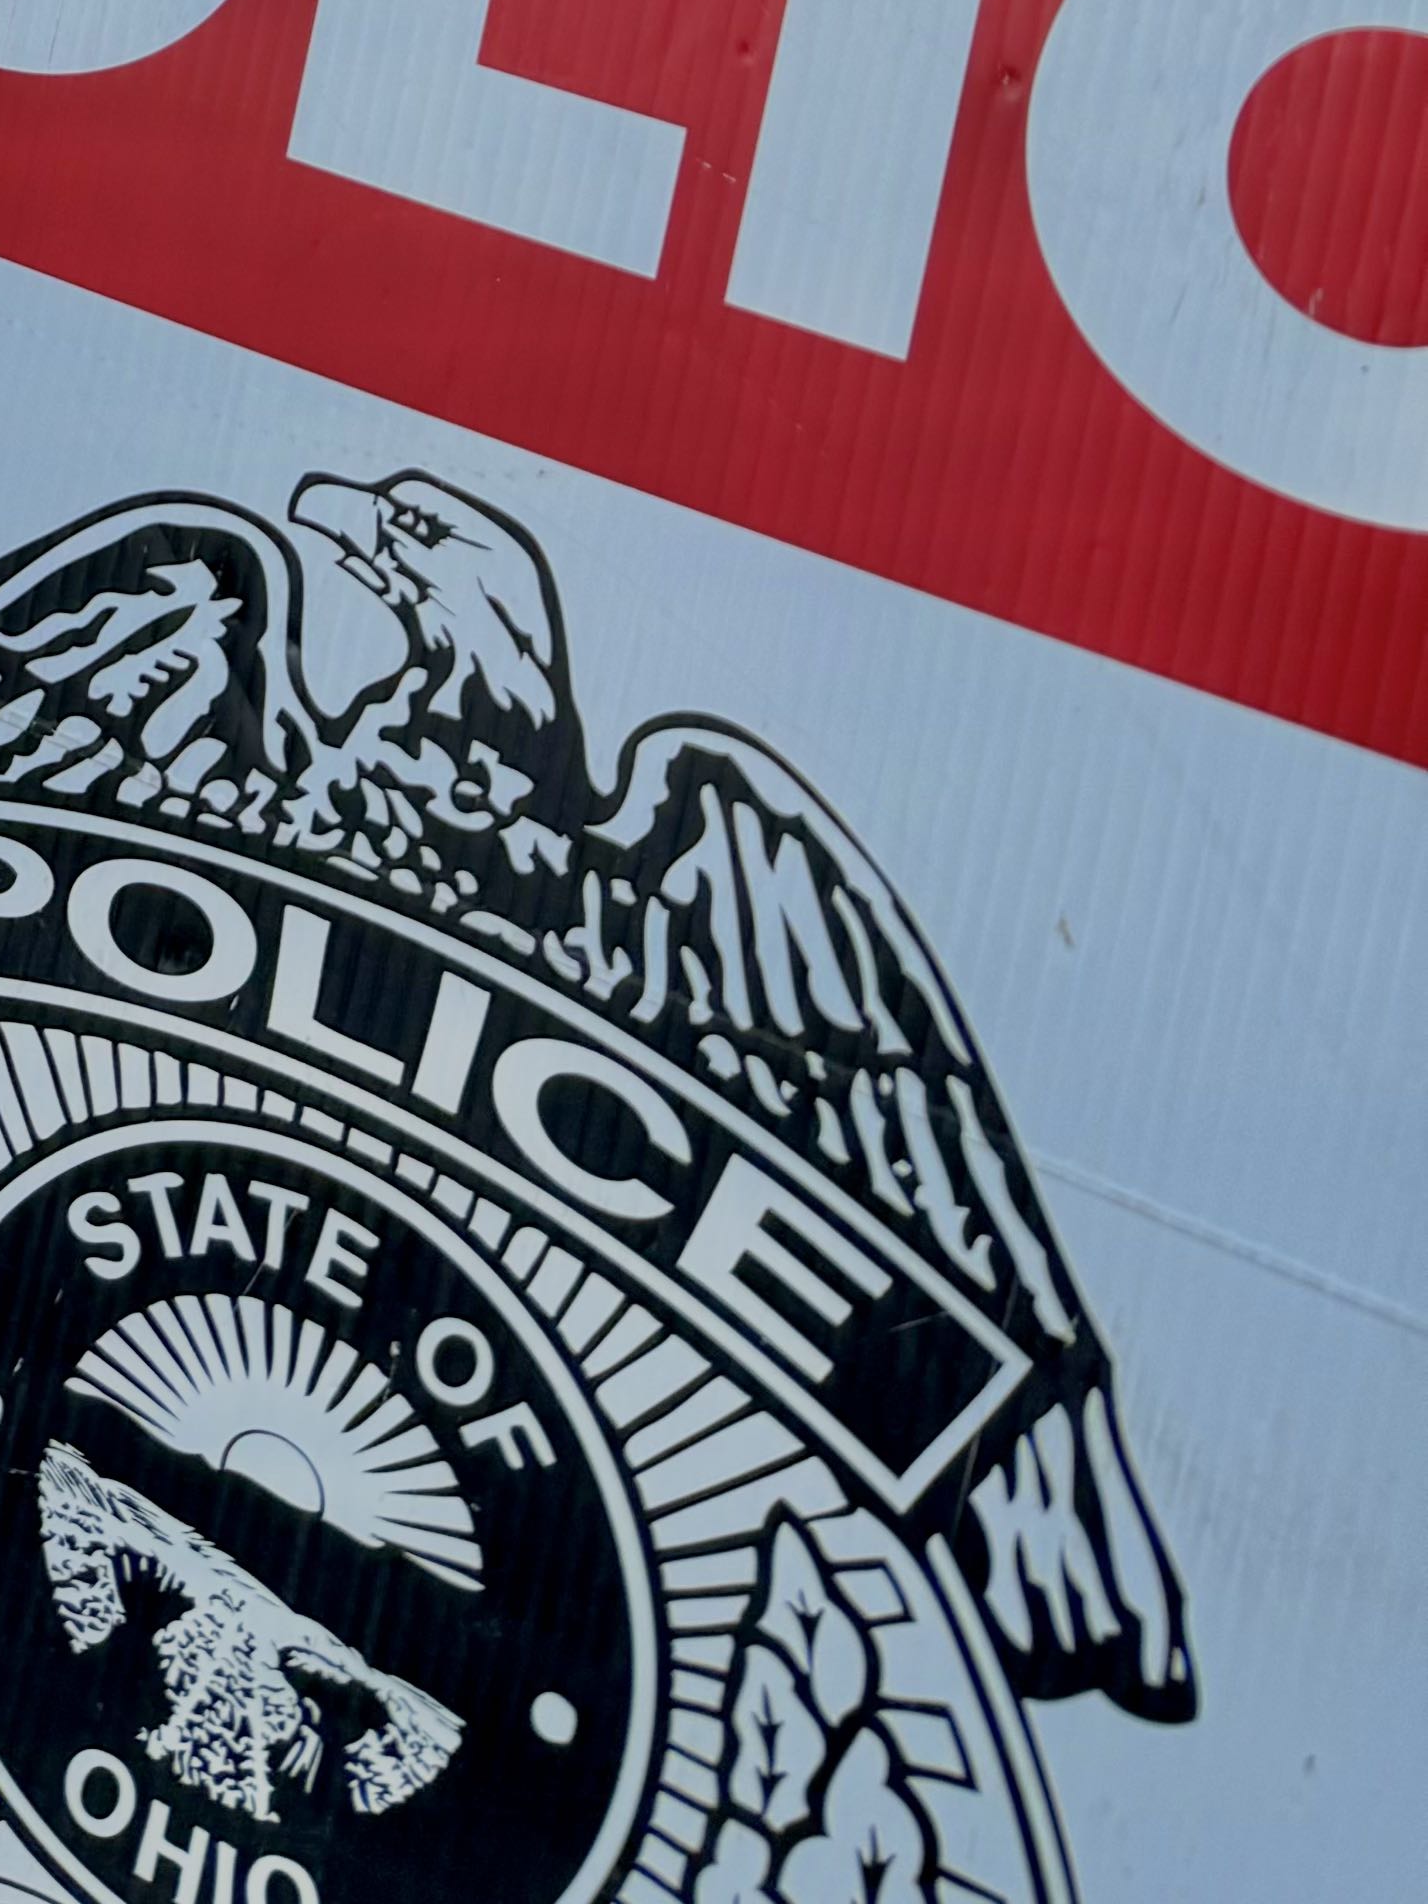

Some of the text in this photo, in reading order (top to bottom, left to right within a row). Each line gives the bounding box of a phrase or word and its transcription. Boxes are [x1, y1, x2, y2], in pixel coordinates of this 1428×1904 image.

[63, 1168, 562, 1476] STATE OF
[63, 1747, 321, 1904] OHIO
